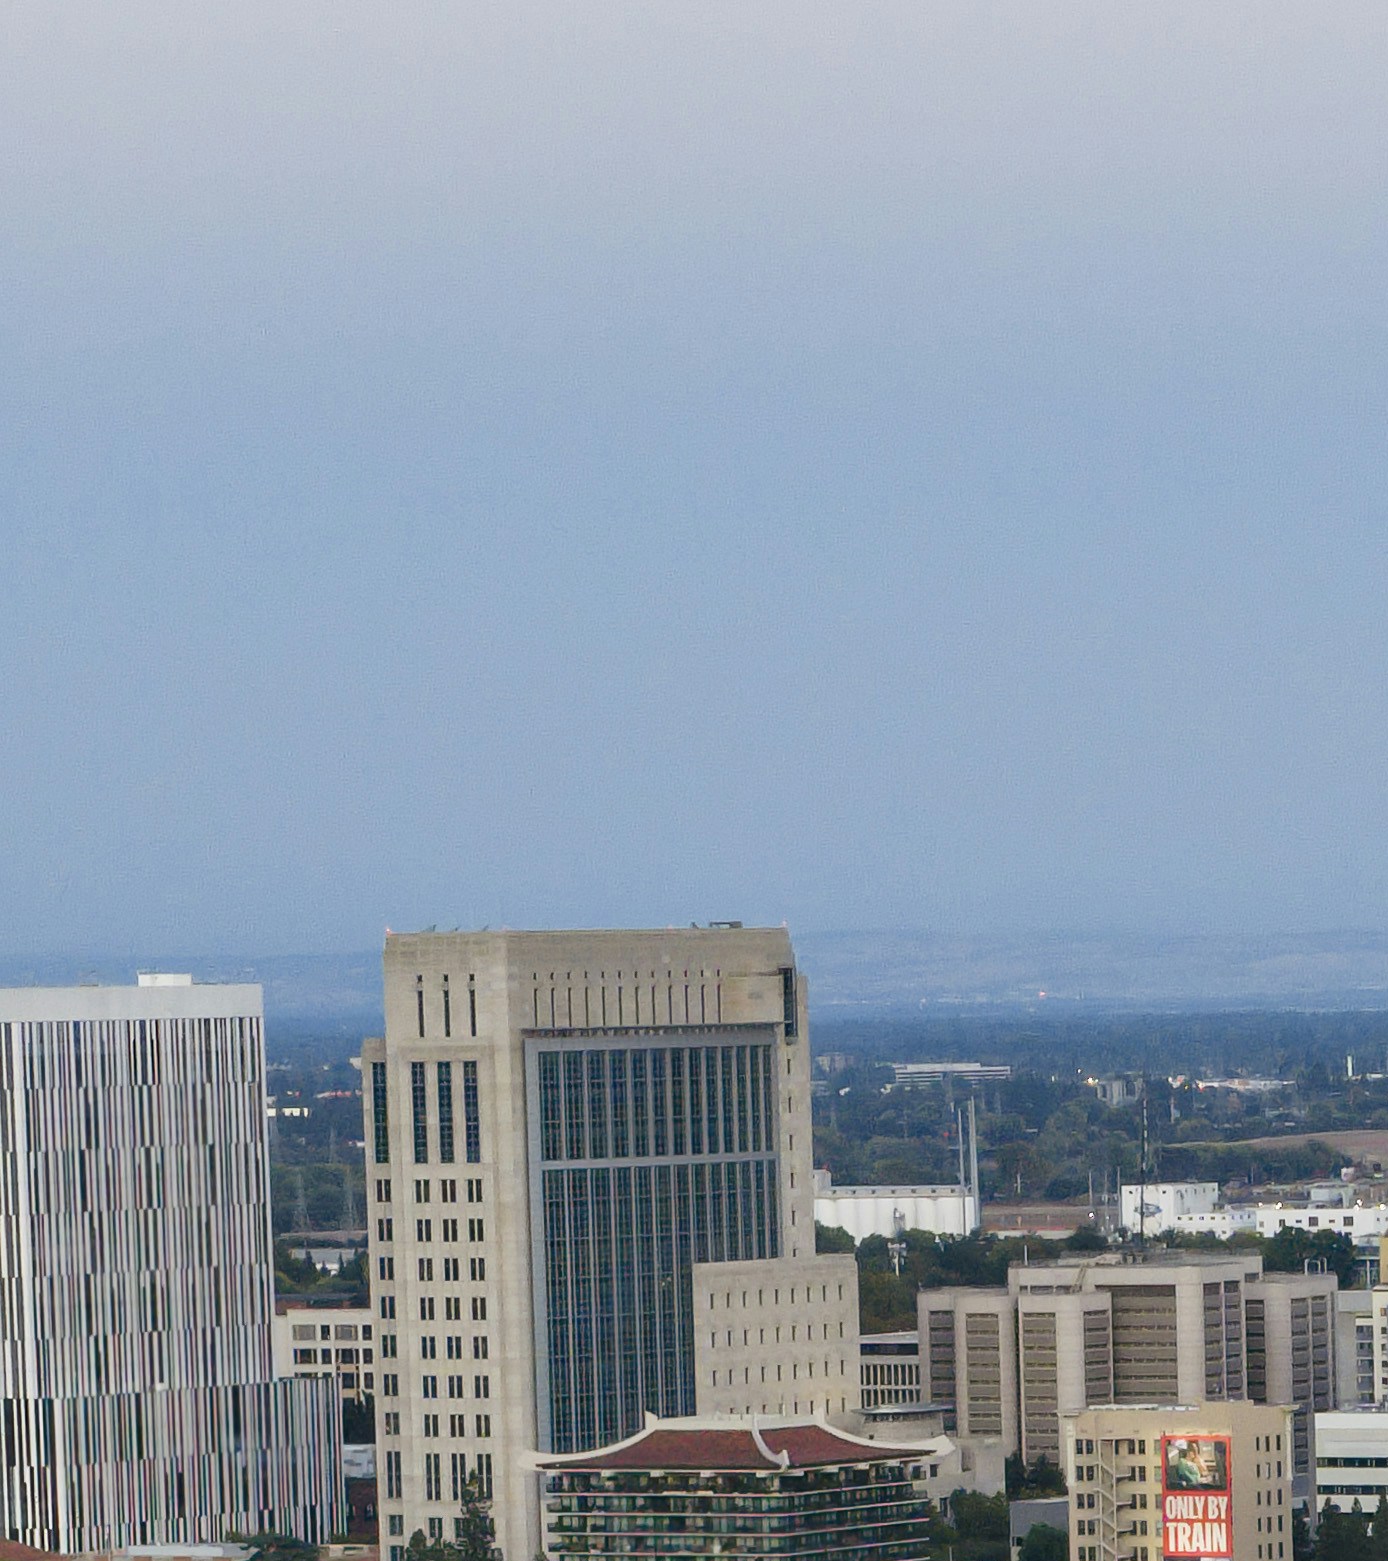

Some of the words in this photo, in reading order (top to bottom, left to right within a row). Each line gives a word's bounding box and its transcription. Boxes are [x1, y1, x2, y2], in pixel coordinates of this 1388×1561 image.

[1165, 1495, 1205, 1520] ONLY
[1208, 1495, 1228, 1520] BY
[1166, 1522, 1227, 1552] TRAIN
